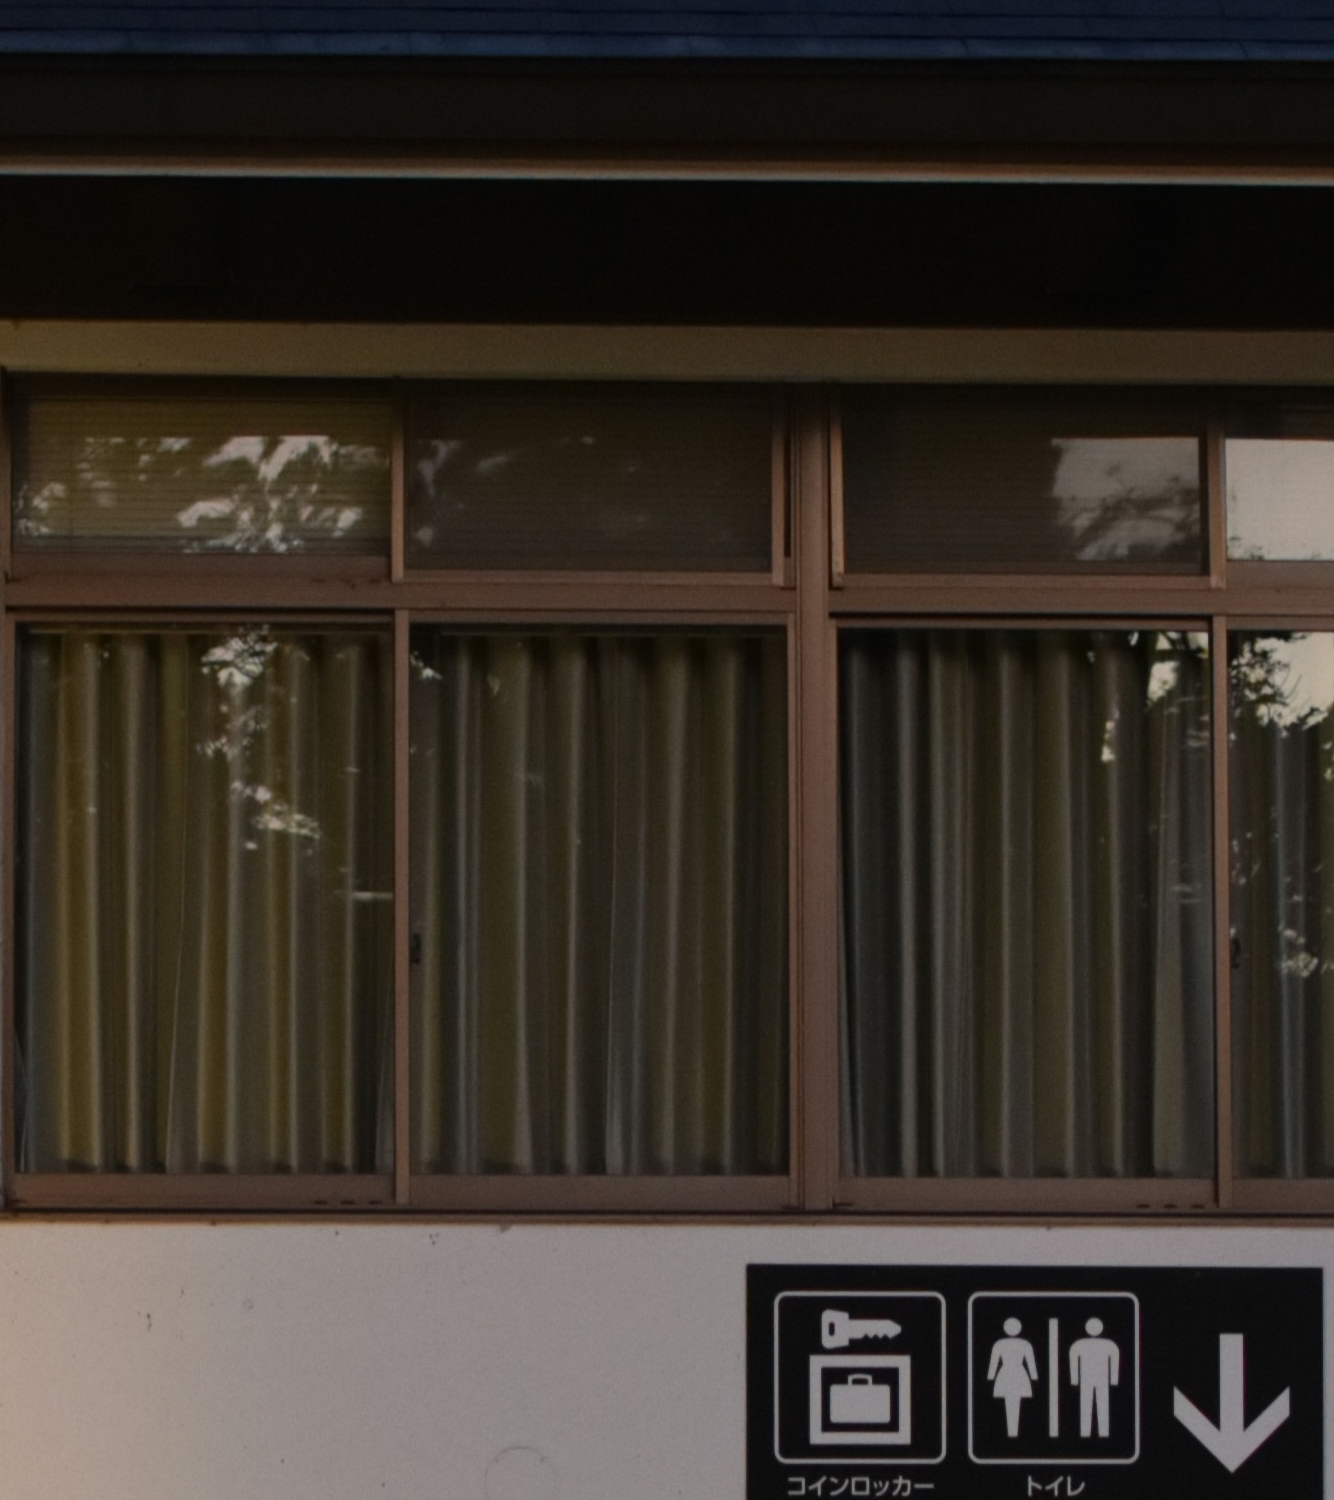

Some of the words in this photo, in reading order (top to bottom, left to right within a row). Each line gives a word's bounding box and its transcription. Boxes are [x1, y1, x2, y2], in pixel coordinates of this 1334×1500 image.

[787, 1475, 935, 1498] コインロッカー
[1027, 1475, 1086, 1497] トイレ
